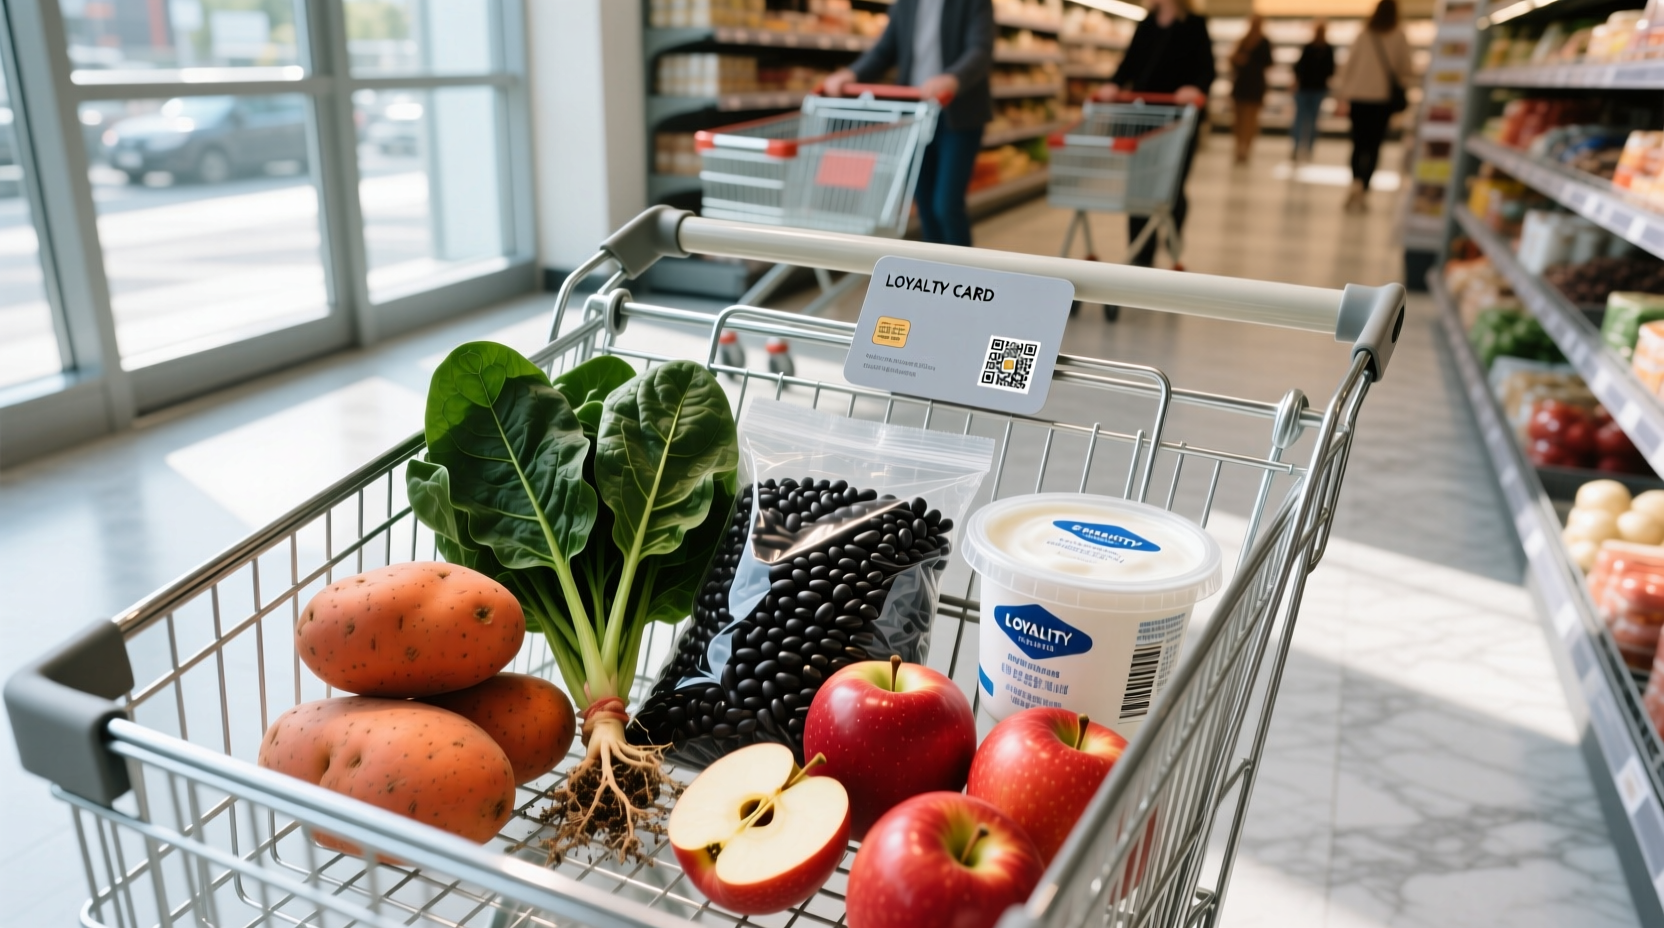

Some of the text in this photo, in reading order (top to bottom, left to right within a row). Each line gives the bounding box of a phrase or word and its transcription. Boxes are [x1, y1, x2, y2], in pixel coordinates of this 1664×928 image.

[885, 273, 995, 302] LOYALTY CARD
[1005, 613, 1072, 646] LOYALITY
